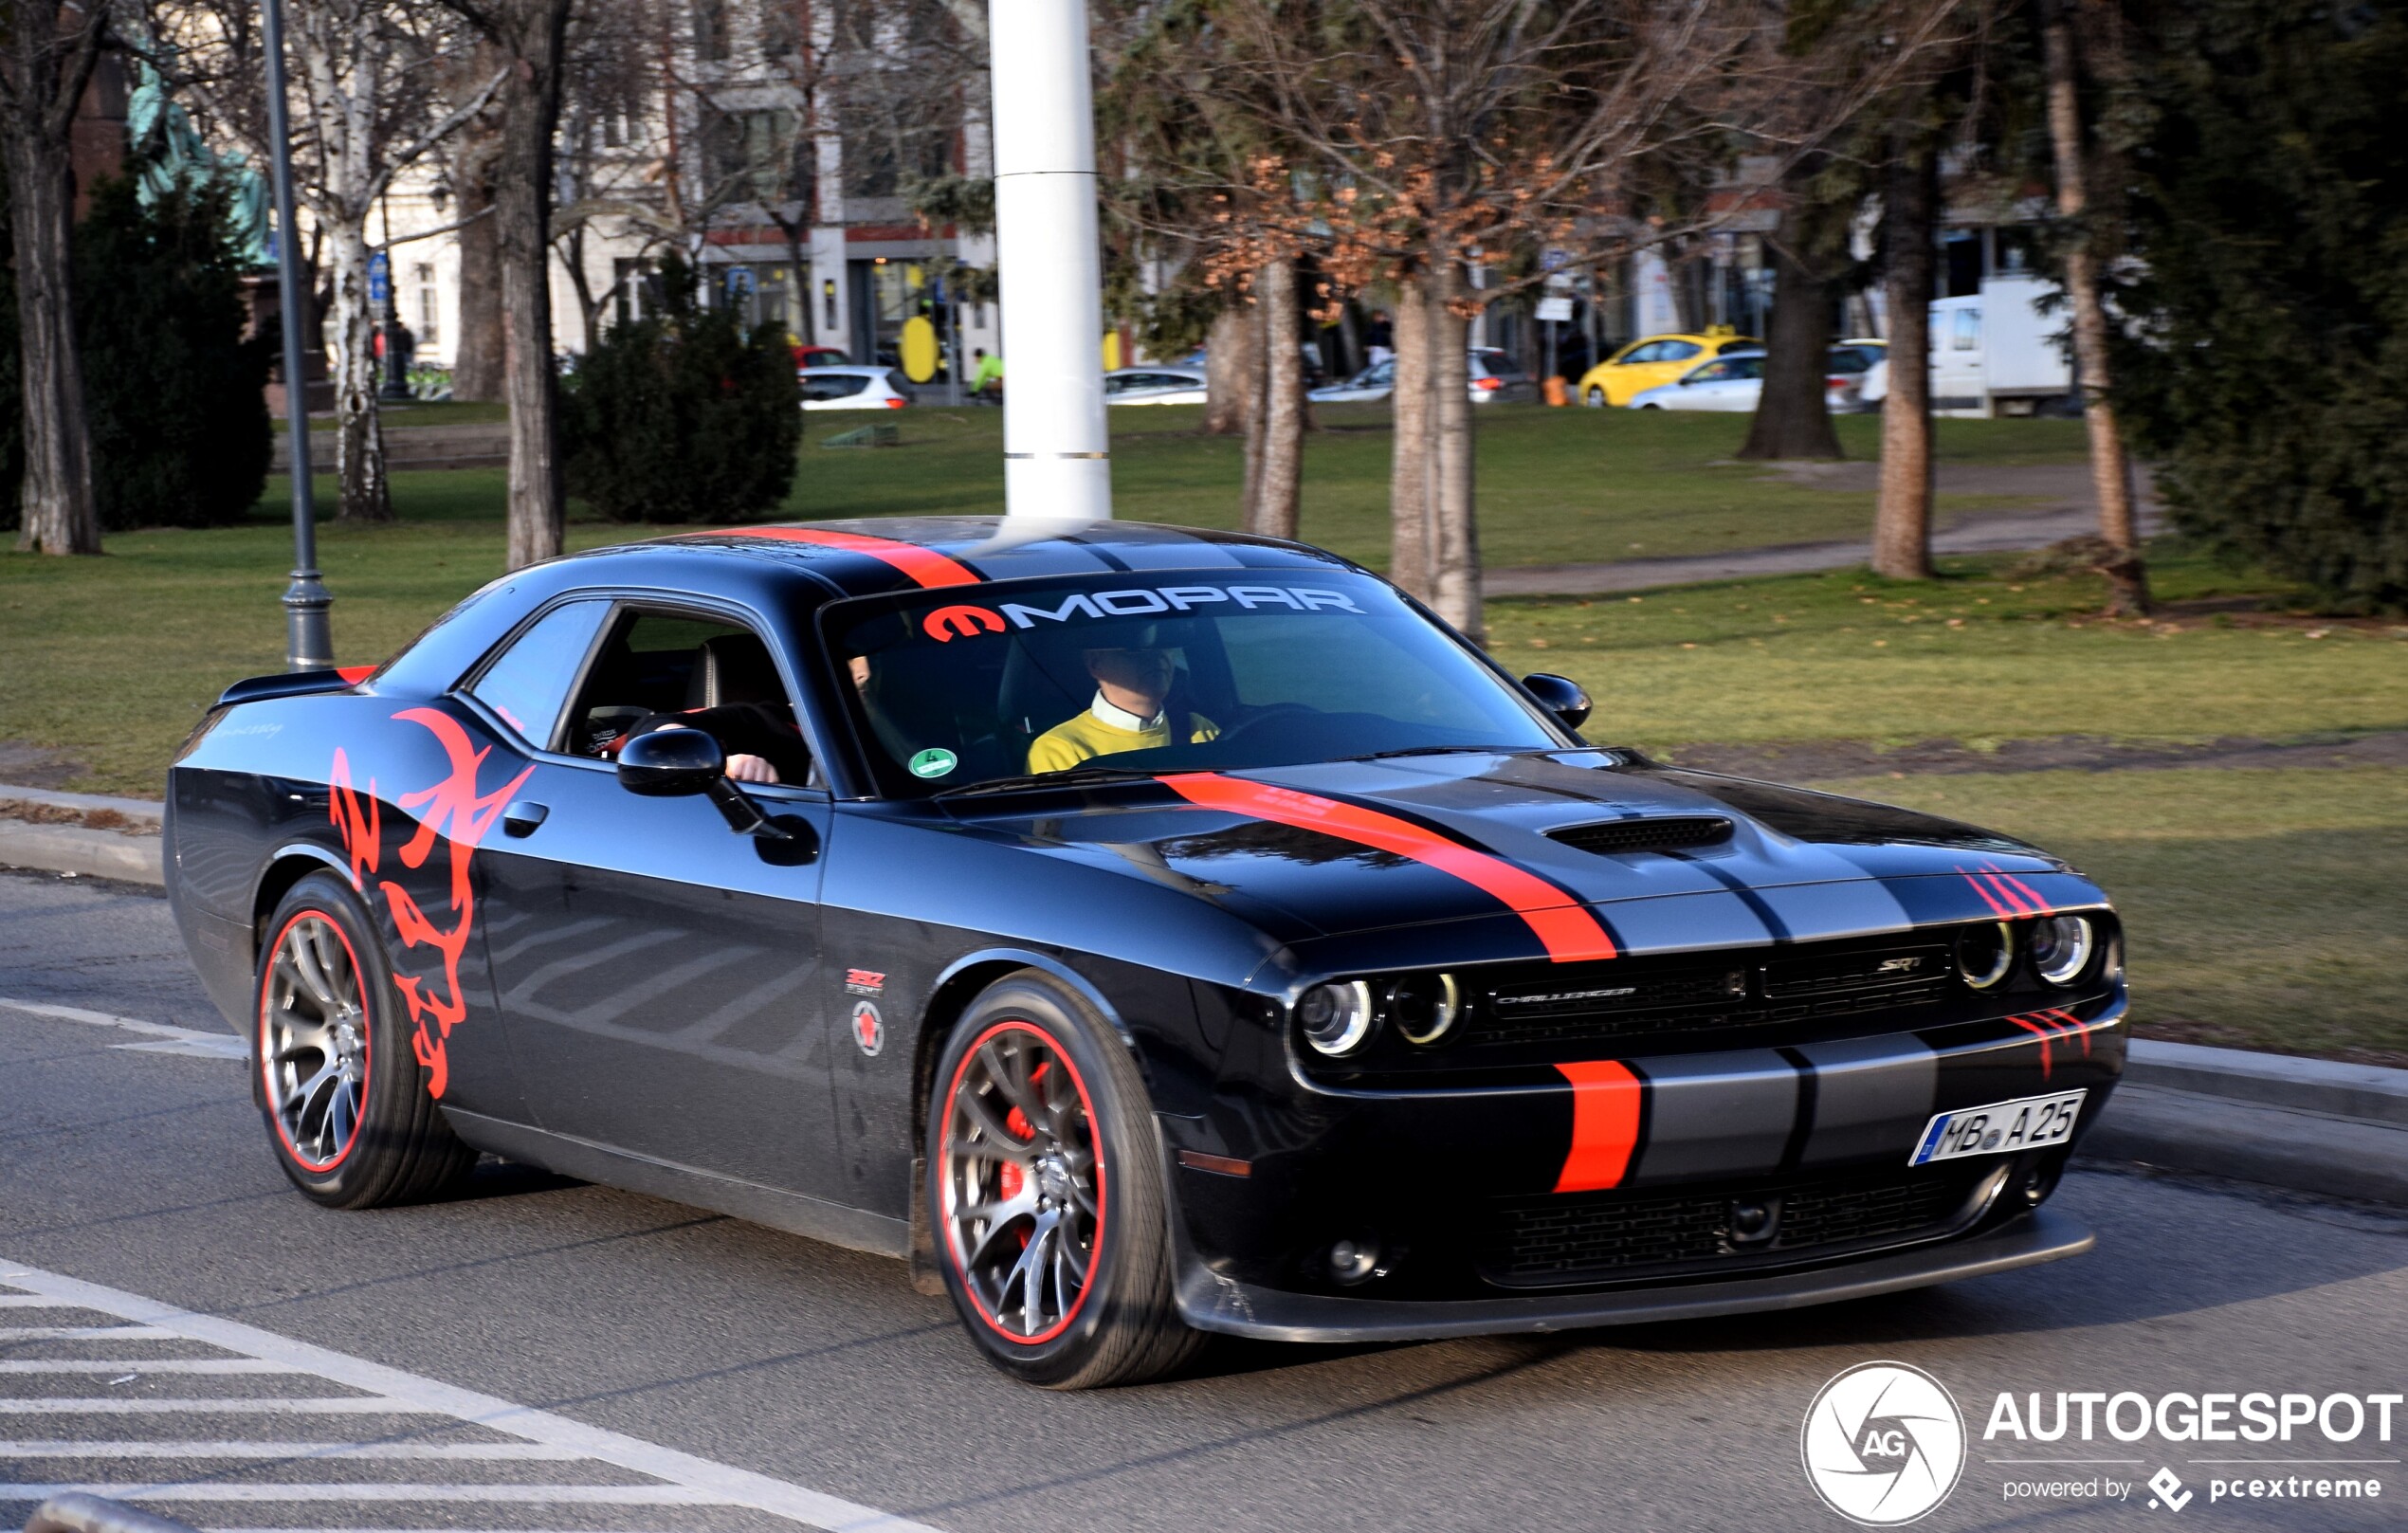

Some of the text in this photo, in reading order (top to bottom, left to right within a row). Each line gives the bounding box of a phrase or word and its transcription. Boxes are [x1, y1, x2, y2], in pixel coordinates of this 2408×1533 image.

[999, 586, 1367, 628] MOPAR
[1877, 958, 1923, 972] SRT
[1496, 988, 1636, 1004] CHALLENGER
[1934, 1113, 1988, 1155] MB
